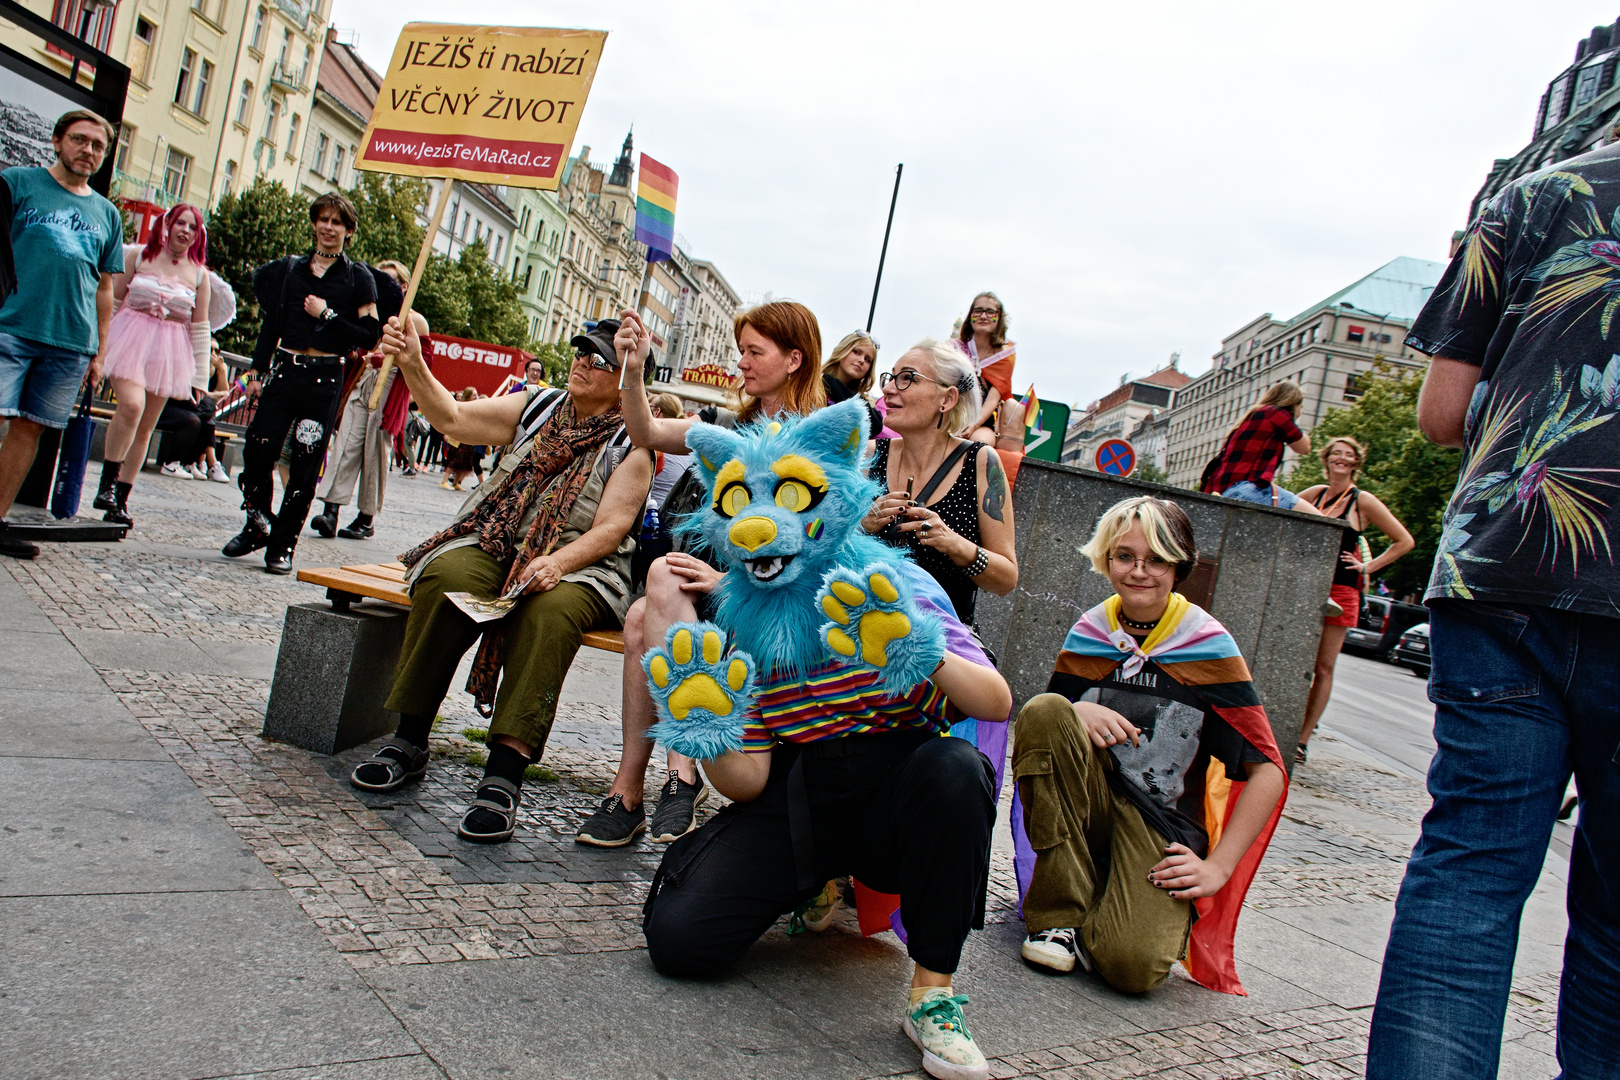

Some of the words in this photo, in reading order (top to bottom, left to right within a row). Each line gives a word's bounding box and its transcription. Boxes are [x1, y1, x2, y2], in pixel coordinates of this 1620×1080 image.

[399, 36, 476, 71] JEŽÍŠ
[478, 45, 495, 69] ti
[501, 46, 590, 77] nabízí
[390, 84, 479, 116] VĚČNÝ
[482, 89, 575, 125] ŽIVOT
[374, 140, 552, 168] www.JezisTeMaRad.cz
[23, 207, 69, 228] Paradise
[659, 368, 670, 383] 11
[684, 369, 733, 389] TRAMVA
[669, 770, 678, 795] SPORT
[605, 793, 623, 814] SPORT
